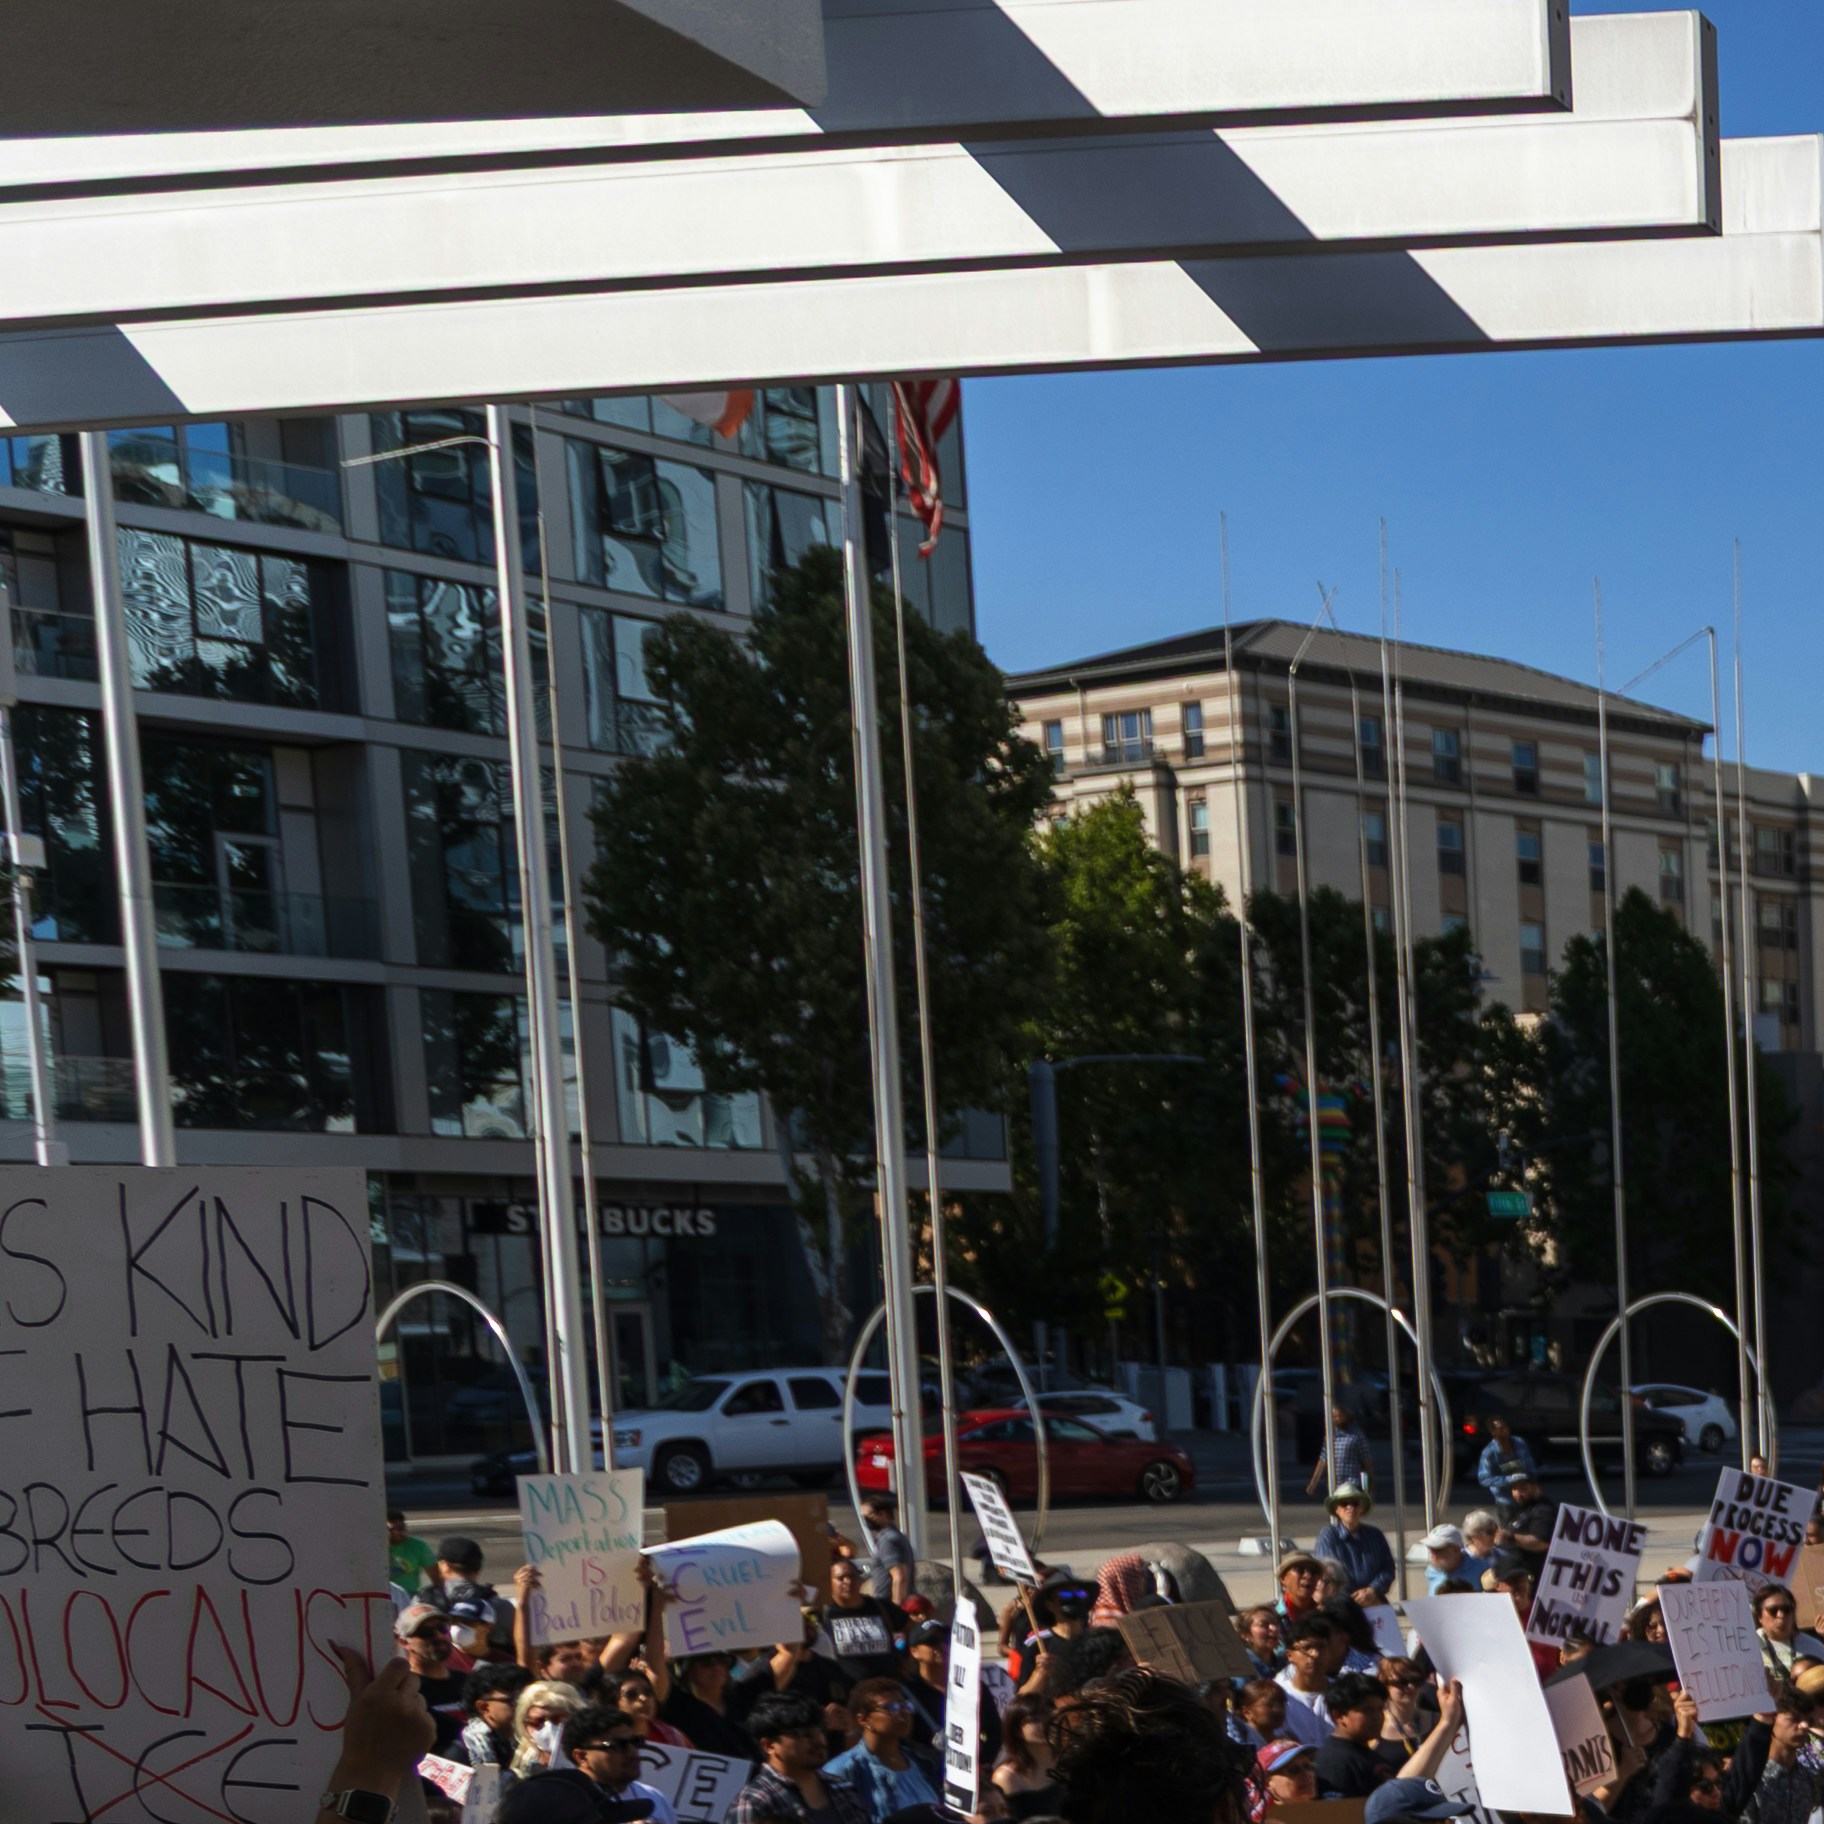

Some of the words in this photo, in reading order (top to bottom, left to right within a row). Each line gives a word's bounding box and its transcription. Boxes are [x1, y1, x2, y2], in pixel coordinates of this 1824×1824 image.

[506, 1204, 718, 1237] STBUCKS
[118, 1182, 371, 1351] KIND
[74, 1342, 372, 1488] HATE
[525, 1479, 631, 1526] MASS
[1734, 1475, 1795, 1514] DUE
[1558, 1504, 1646, 1557] NONE
[1710, 1498, 1804, 1546] PROCESS
[581, 1557, 608, 1588] IS
[1547, 1556, 1625, 1597] THIS
[1707, 1528, 1798, 1579] NOW
[532, 1593, 582, 1638] Bad
[590, 1586, 643, 1628] Policy
[1662, 1588, 1699, 1624] OUR
[1681, 1622, 1711, 1660] IS
[1712, 1624, 1751, 1654] THE
